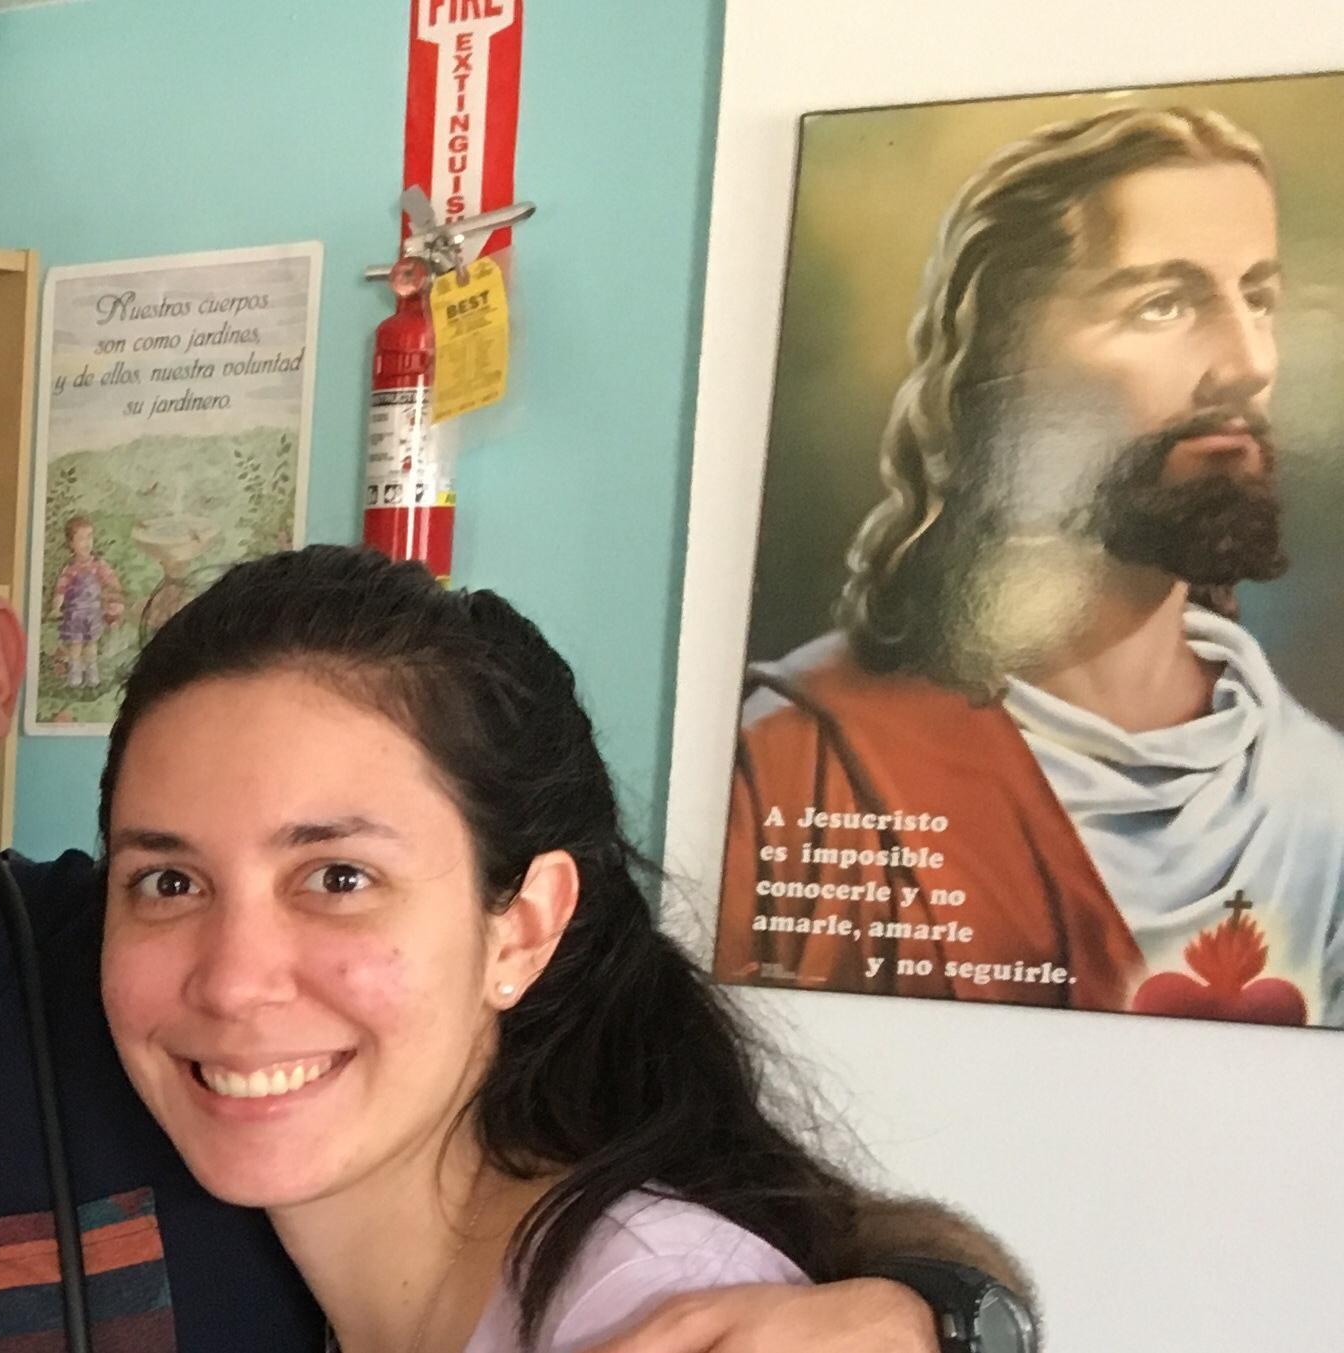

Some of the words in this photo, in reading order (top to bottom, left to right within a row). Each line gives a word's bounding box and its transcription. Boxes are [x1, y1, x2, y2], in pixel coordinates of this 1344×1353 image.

[96, 291, 192, 325] Nuestros
[198, 293, 270, 317] cuerpos
[446, 290, 490, 320] BEST
[94, 337, 126, 355] son
[133, 333, 181, 352] como
[185, 321, 261, 353] jardines,
[53, 374, 66, 396] y
[73, 364, 95, 389] de
[150, 359, 215, 383] nuestra
[223, 346, 306, 376] voluntad
[123, 400, 145, 416] su
[763, 806, 786, 828] A
[797, 806, 948, 833] Jesucristo
[759, 844, 788, 863] es
[801, 842, 945, 869] imposible
[756, 879, 891, 903] conocerle
[900, 886, 920, 907] y
[929, 888, 967, 906] no
[752, 914, 862, 942] amarle,
[868, 918, 974, 944] amarle
[864, 956, 885, 978] y
[896, 957, 933, 976] no
[944, 959, 1078, 986] seguirle.
